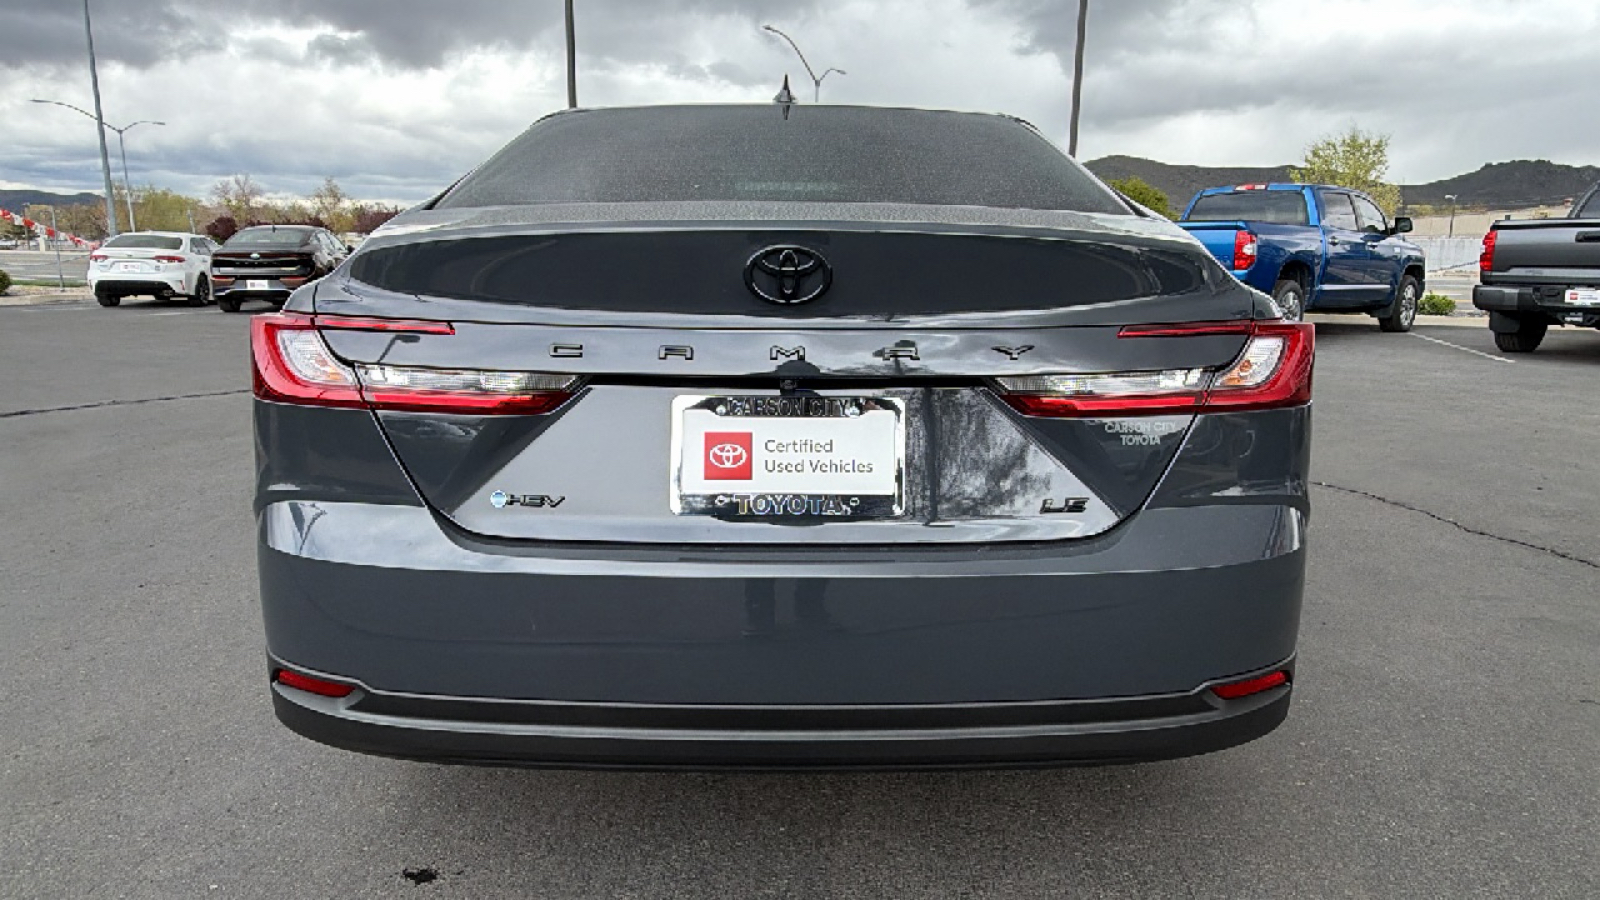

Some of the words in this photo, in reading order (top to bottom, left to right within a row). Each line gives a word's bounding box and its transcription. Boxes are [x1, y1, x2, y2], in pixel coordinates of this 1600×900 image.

[549, 343, 1035, 361] CAMRY
[729, 397, 805, 417] CARSON
[808, 397, 850, 417] CITY
[1104, 421, 1150, 433] CARSON
[1154, 421, 1177, 432] CITY
[764, 439, 833, 453] Certified
[1120, 434, 1161, 446] TOYOTA
[764, 459, 805, 473] Used
[809, 458, 873, 473] Vehicles
[734, 494, 841, 515] TOYOTA
[1040, 497, 1090, 514] LE
